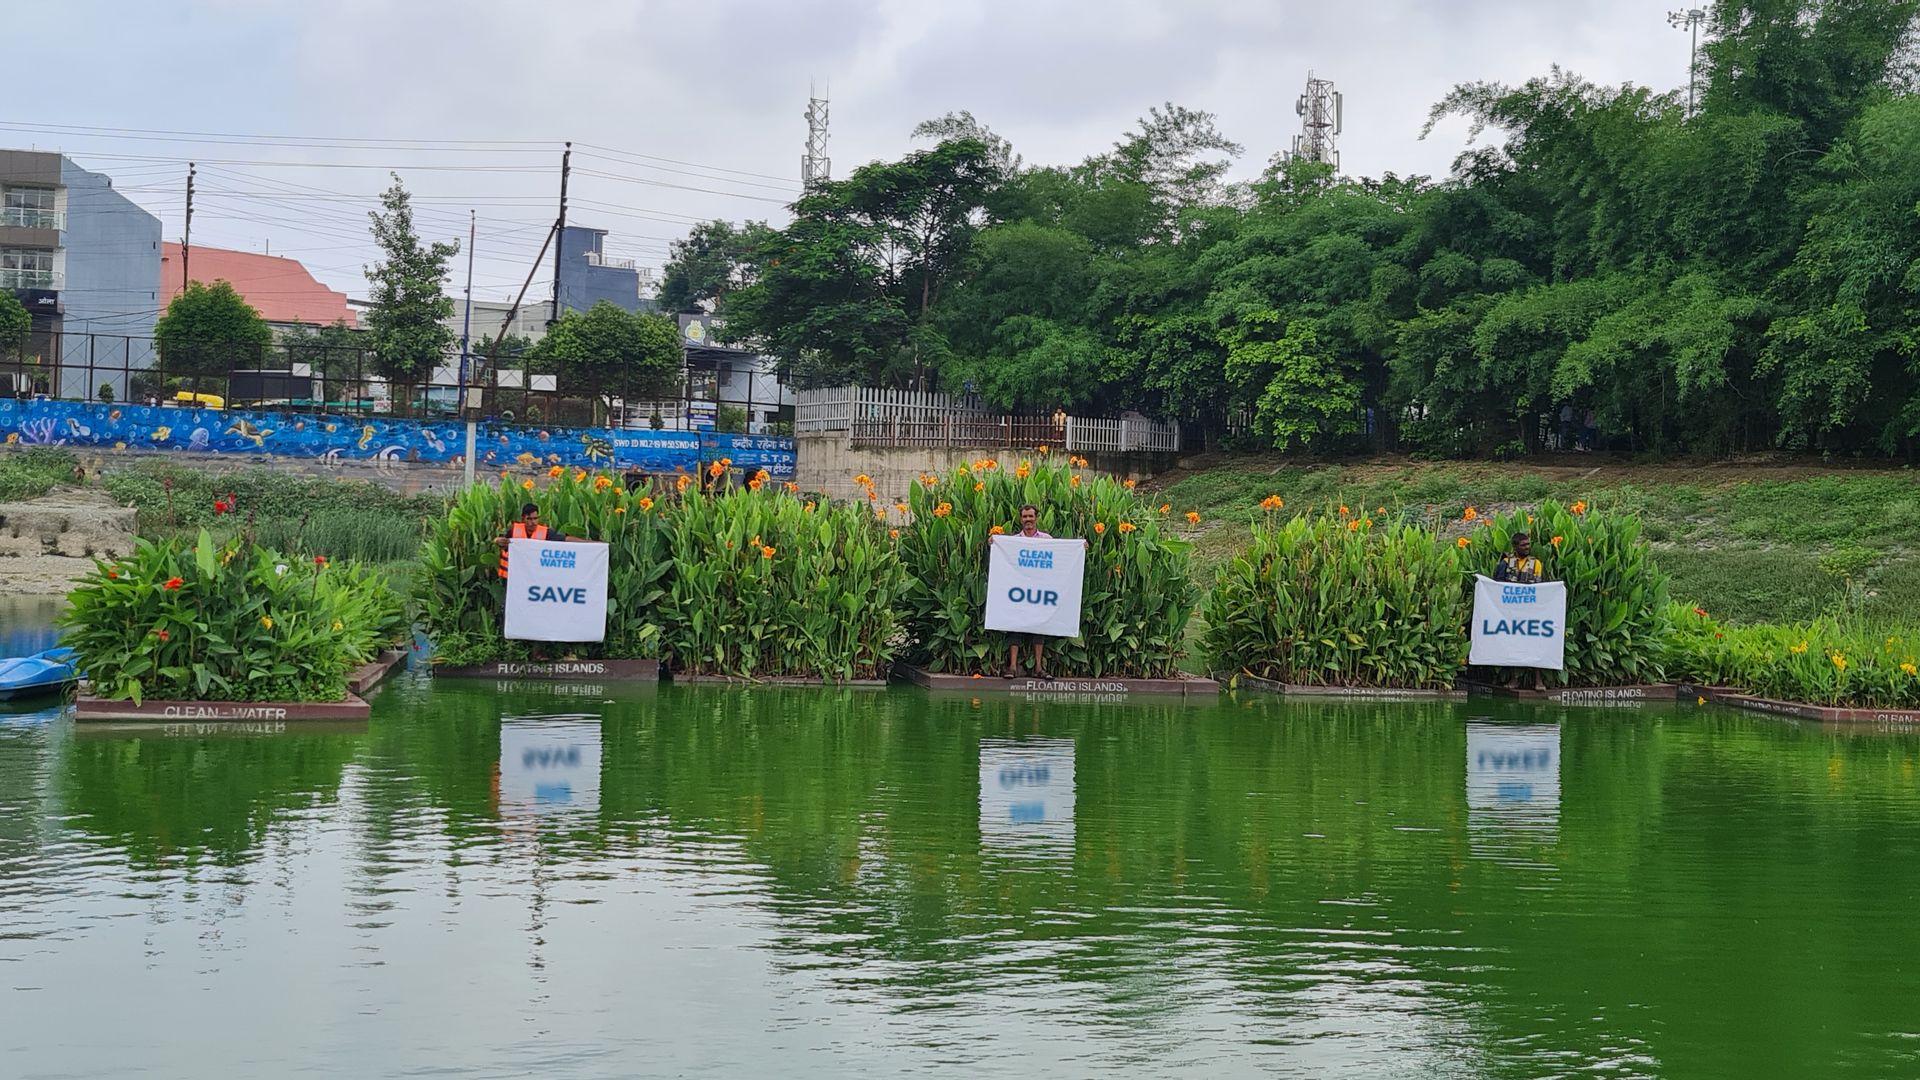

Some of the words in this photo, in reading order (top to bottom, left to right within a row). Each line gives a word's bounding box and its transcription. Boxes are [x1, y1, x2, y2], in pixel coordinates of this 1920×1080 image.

[760, 453, 793, 463] S.T.P.
[541, 548, 577, 559] CLEAN
[1019, 549, 1053, 560] CLEAN
[540, 558, 576, 569] WATER
[1017, 557, 1053, 569] WATER
[528, 585, 587, 605] SAVE
[1503, 585, 1536, 595] CLEAN
[1008, 587, 1058, 606] OUR
[1501, 594, 1537, 604] WATER
[1483, 619, 1554, 638] LAKES
[164, 706, 218, 719] CLEAN
[232, 707, 287, 720] WATER
